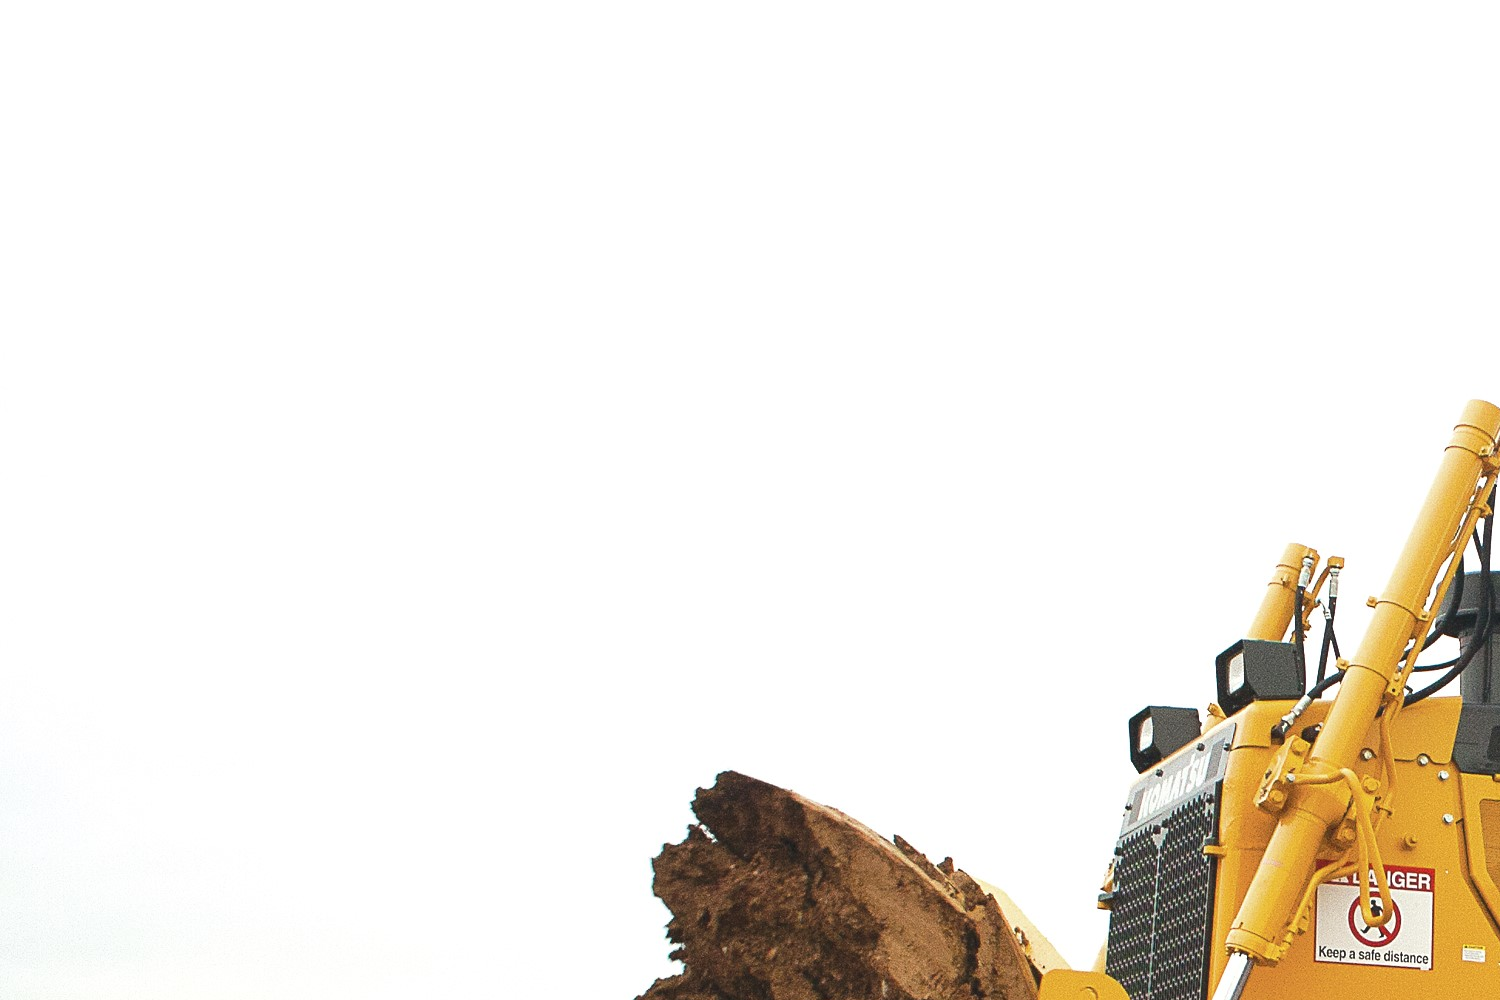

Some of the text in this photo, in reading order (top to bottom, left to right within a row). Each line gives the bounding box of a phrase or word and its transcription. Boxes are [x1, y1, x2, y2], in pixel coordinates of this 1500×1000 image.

[1138, 752, 1211, 820] KOMATSU
[1319, 946, 1429, 964] Keep a safe distance
